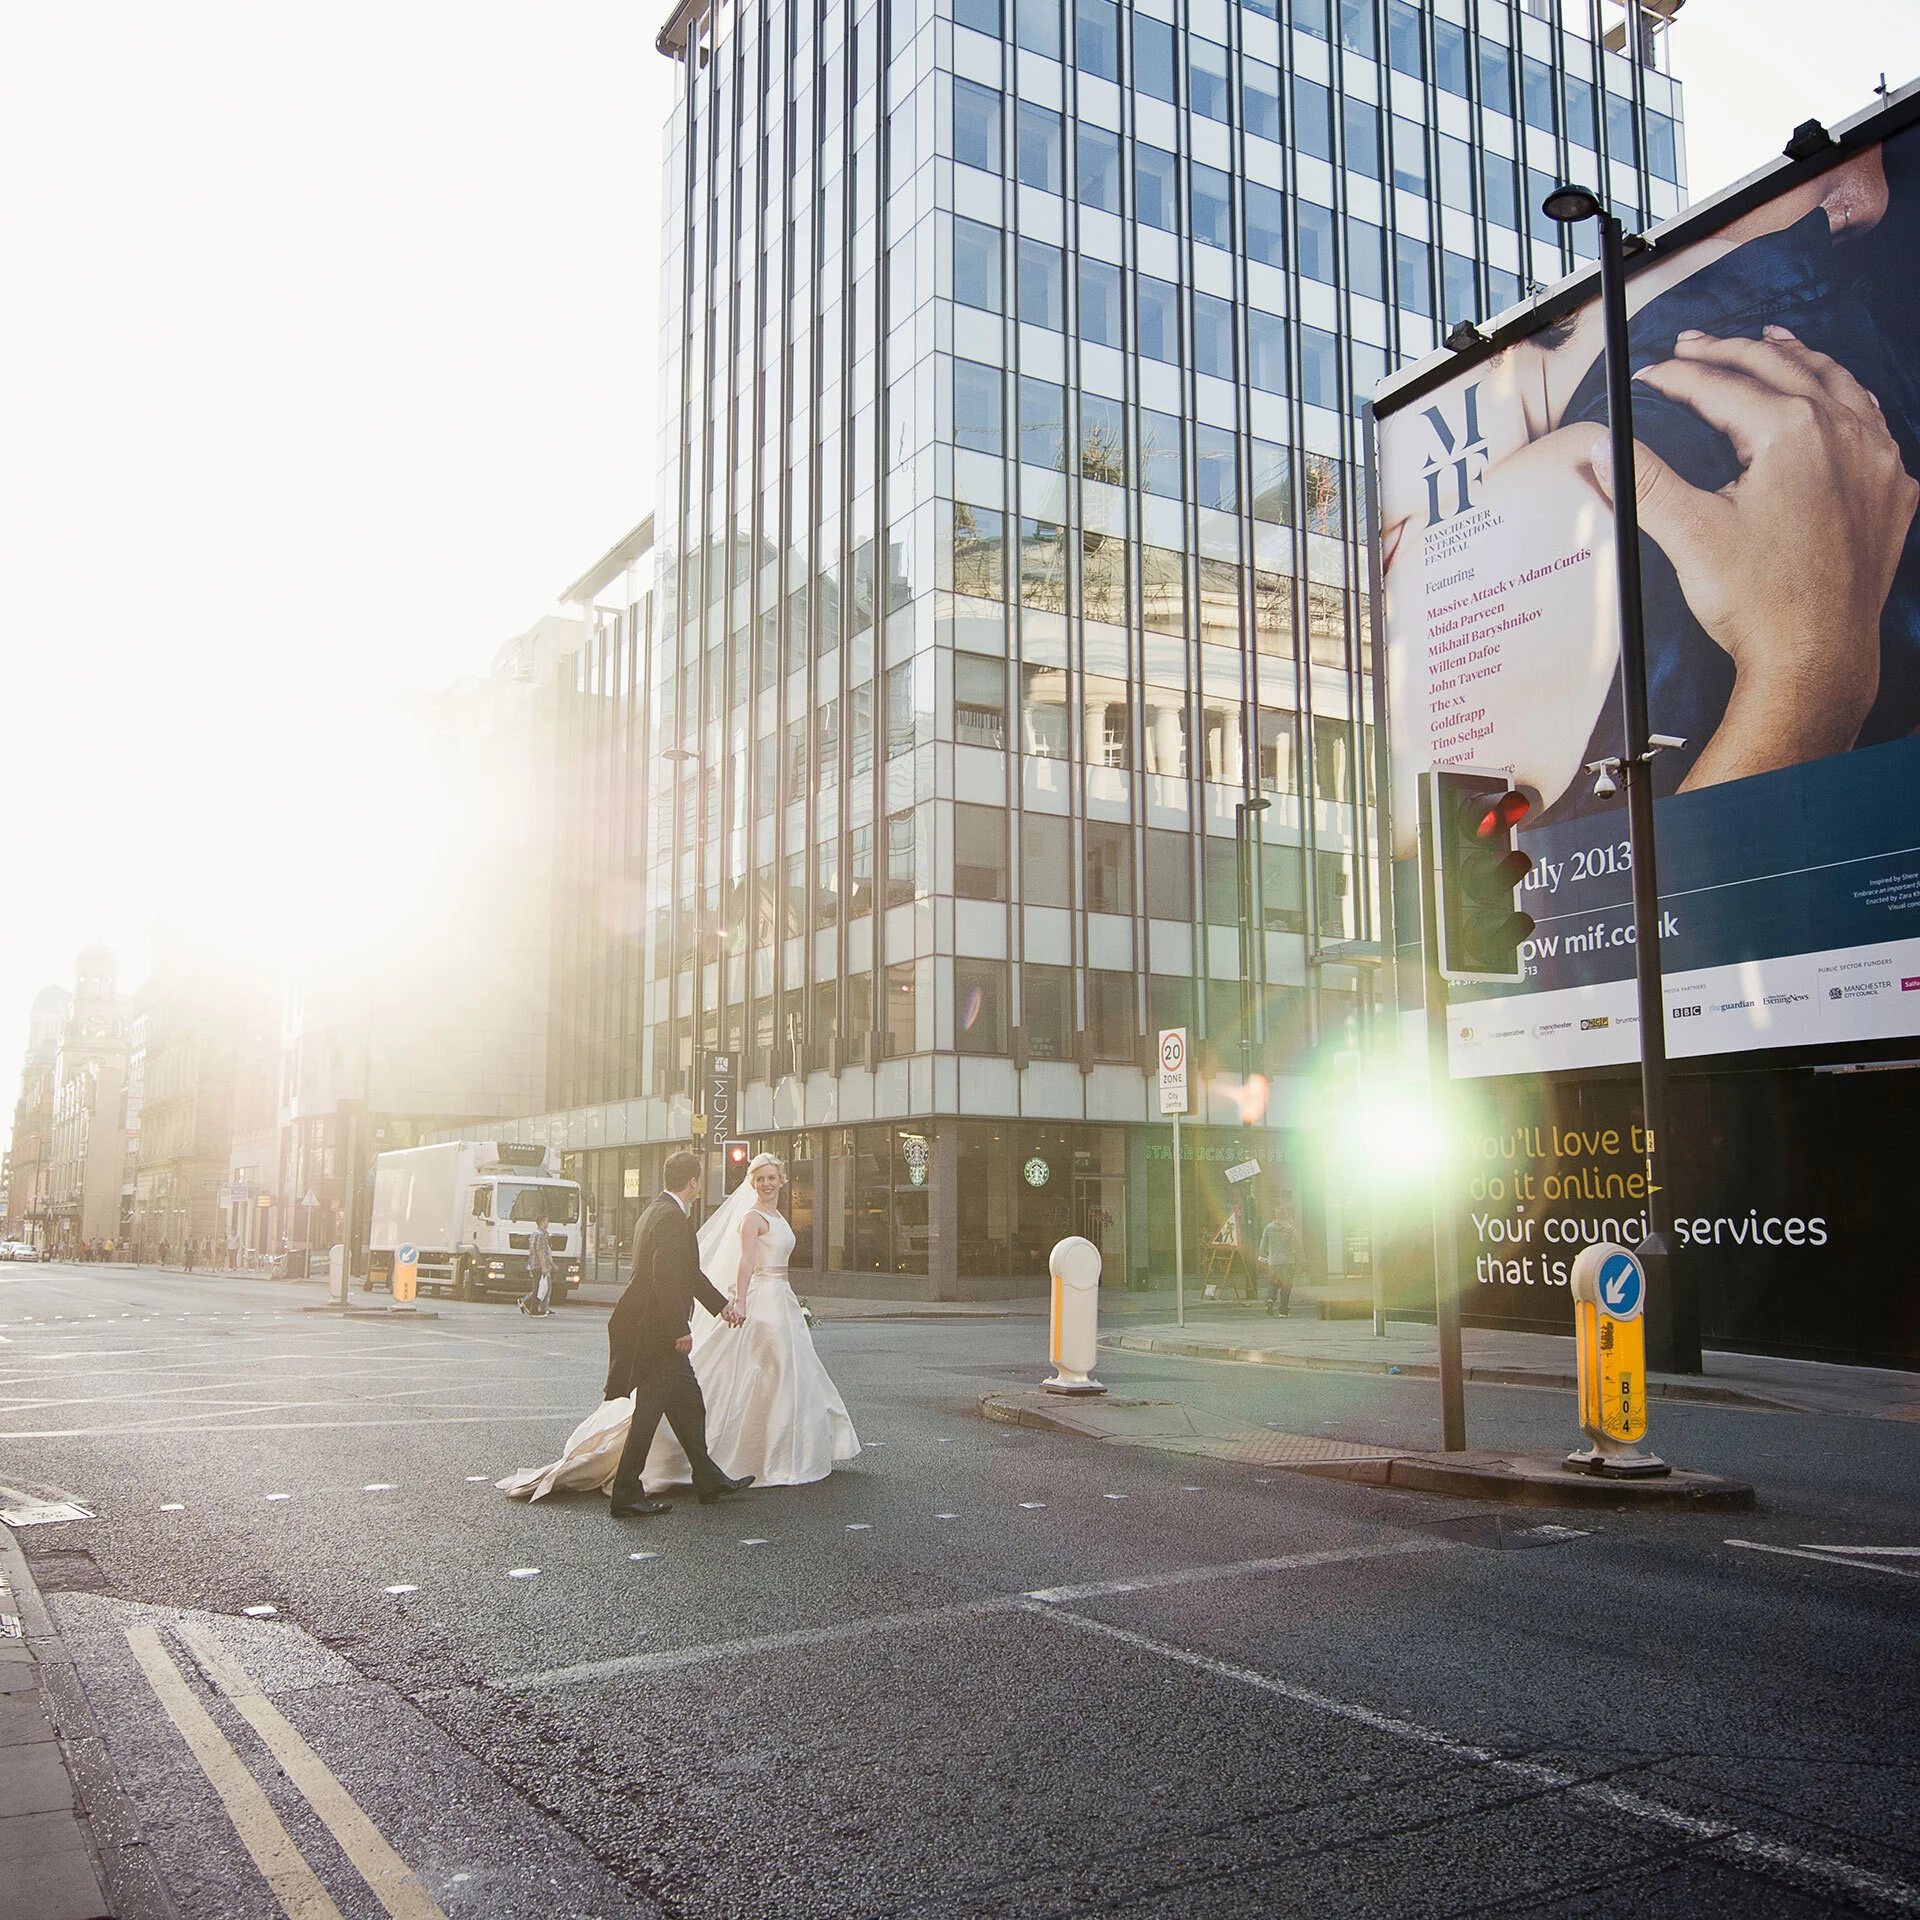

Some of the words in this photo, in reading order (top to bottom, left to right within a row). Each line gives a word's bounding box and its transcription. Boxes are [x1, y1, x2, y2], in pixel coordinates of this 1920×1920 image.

[1424, 510, 1491, 543] MANCHESTER
[1424, 515, 1505, 555] INTERNATIONAL
[1425, 542, 1470, 566] FESTIVAL
[1426, 568, 1475, 594] Featuring
[1427, 599, 1469, 621] Massive
[1471, 581, 1507, 604] Attack
[1508, 578, 1517, 588] v
[1517, 564, 1552, 586] Adam
[1554, 548, 1592, 571] Curtis
[1427, 620, 1459, 639] Abida
[1460, 603, 1505, 627] Parveen
[1428, 632, 1469, 657] Mikhail
[1471, 608, 1543, 643] Baryshnikov
[1429, 656, 1466, 676] Willem
[1468, 643, 1501, 662] Dafoe
[1429, 679, 1456, 695] John
[1458, 663, 1502, 685] Tavener
[1429, 700, 1451, 713] The
[1431, 708, 1485, 732] Goldfrapp
[1431, 736, 1456, 751] Tino
[1458, 722, 1494, 743] Sehgal
[1432, 747, 1474, 766] Mogwai
[1521, 857, 1564, 893] uly
[1570, 841, 1632, 882] 2013
[1522, 935, 1559, 961] ow
[1864, 959, 1893, 967] FUNDERS
[1681, 984, 1707, 992] PARTNERS
[1844, 981, 1891, 992] MANCHESTER
[1673, 1005, 1701, 1018] BBC
[1165, 1044, 1181, 1060] 20
[1163, 1074, 1183, 1084] ZONE
[1165, 1101, 1182, 1109] centre
[1168, 1092, 1179, 1101] City
[713, 1080, 728, 1145] RNCM
[1470, 1127, 1545, 1160] You'll
[1552, 1125, 1620, 1157] love
[1631, 1124, 1645, 1154] t
[1470, 1171, 1505, 1201] do
[1513, 1169, 1535, 1200] it
[1543, 1166, 1645, 1200] online
[1471, 1212, 1535, 1243] Your
[1543, 1210, 1648, 1244] counci
[1674, 1208, 1828, 1246] services
[1476, 1253, 1535, 1285] that
[1541, 1253, 1568, 1286] is
